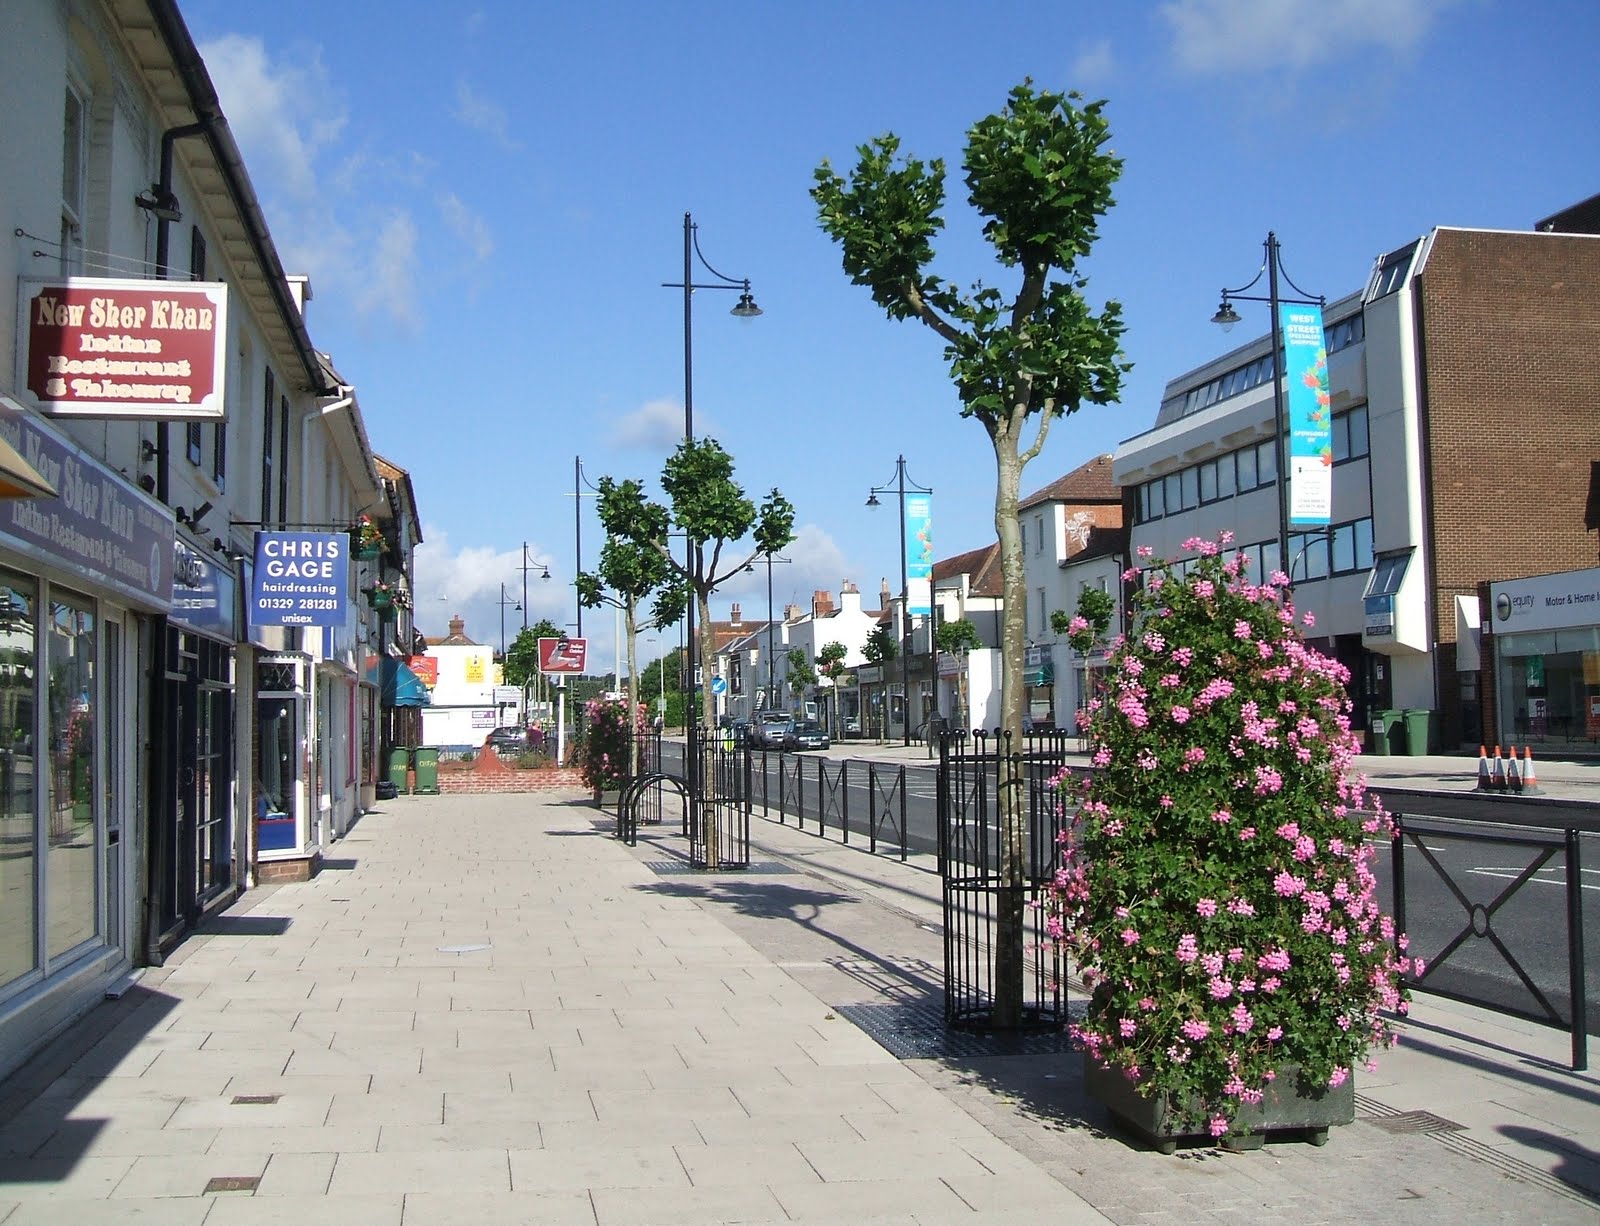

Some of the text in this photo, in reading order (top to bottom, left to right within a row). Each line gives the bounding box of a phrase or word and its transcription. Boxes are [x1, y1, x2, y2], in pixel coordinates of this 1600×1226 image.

[37, 296, 213, 331] New Sher Khan
[79, 334, 162, 354] Indian
[47, 356, 191, 377] Restaurant
[71, 378, 192, 403] Takeaway
[64, 456, 99, 520] Sher
[101, 478, 135, 542] Khan
[12, 501, 50, 540] Indian
[264, 540, 339, 559] CHRIS
[267, 561, 333, 578] GAGE
[262, 582, 337, 595] hairdressing
[259, 598, 338, 610] 01329 281281
[1512, 595, 1535, 608] equity
[1545, 597, 1565, 607] Motor
[1567, 594, 1573, 604] &
[1574, 593, 1596, 604] Home
[281, 613, 313, 623] unisex
